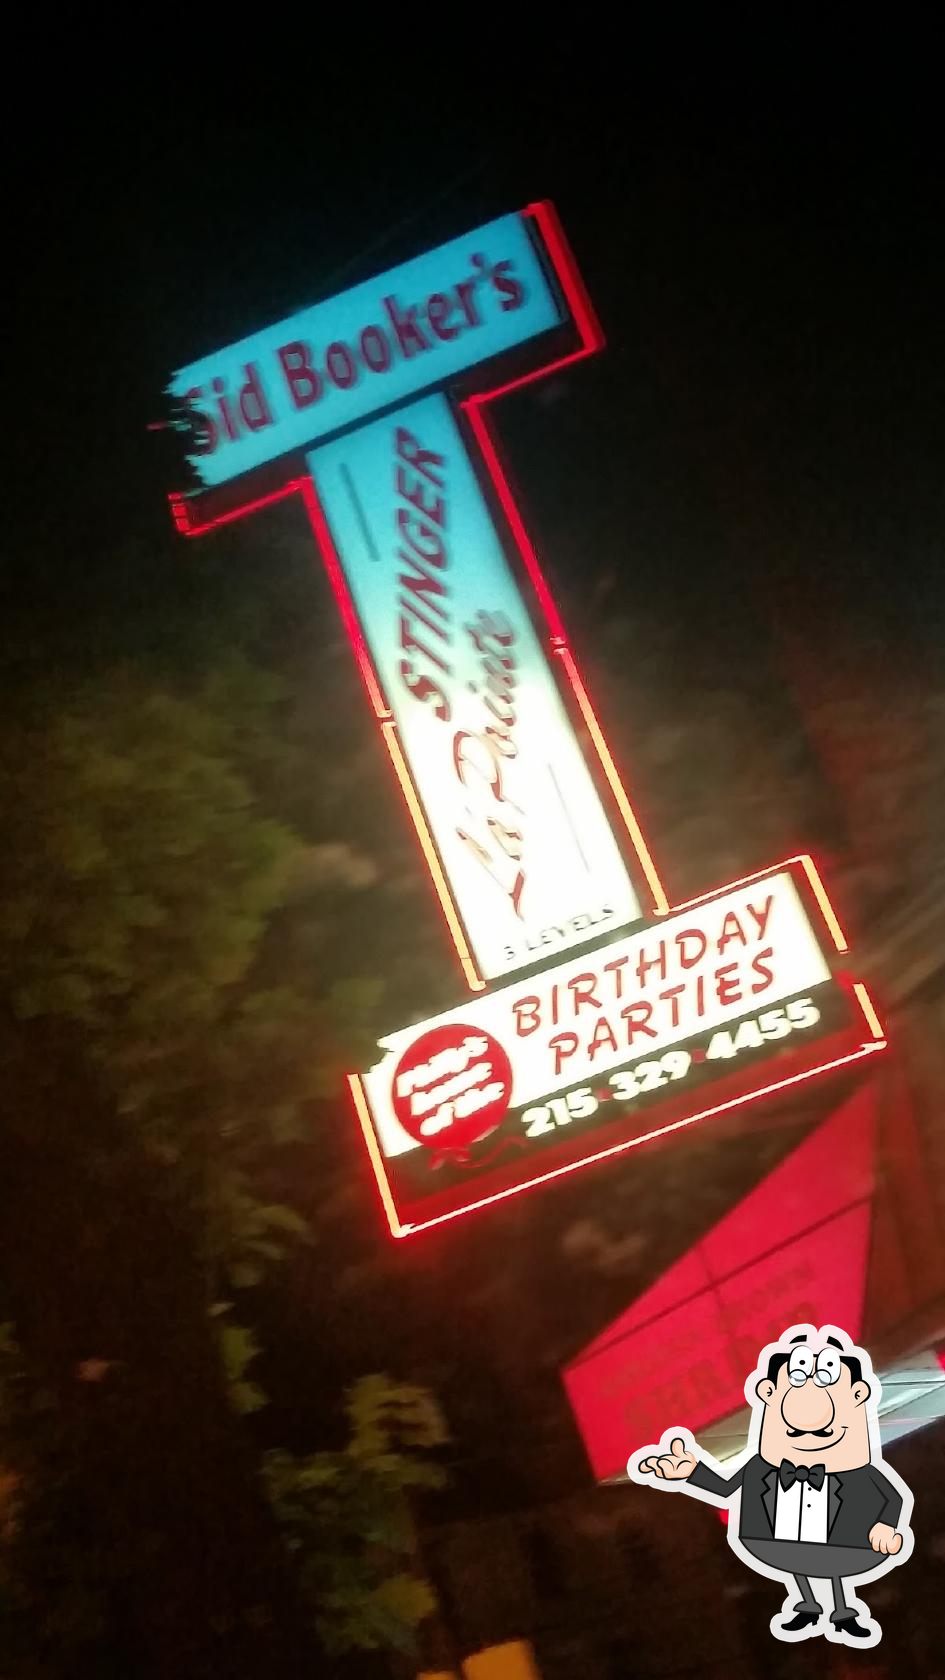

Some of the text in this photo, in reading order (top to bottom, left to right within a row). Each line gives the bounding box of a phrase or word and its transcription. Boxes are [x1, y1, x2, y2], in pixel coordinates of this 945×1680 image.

[276, 250, 528, 410] Booker's
[394, 424, 450, 722] STINGER
[512, 894, 775, 1039] BIRTHDAY
[525, 903, 613, 949] LEVELS
[520, 1086, 600, 1138] 215
[606, 1049, 694, 1100] 329
[704, 997, 822, 1062] 4455
[548, 947, 777, 1077] PARTIES
